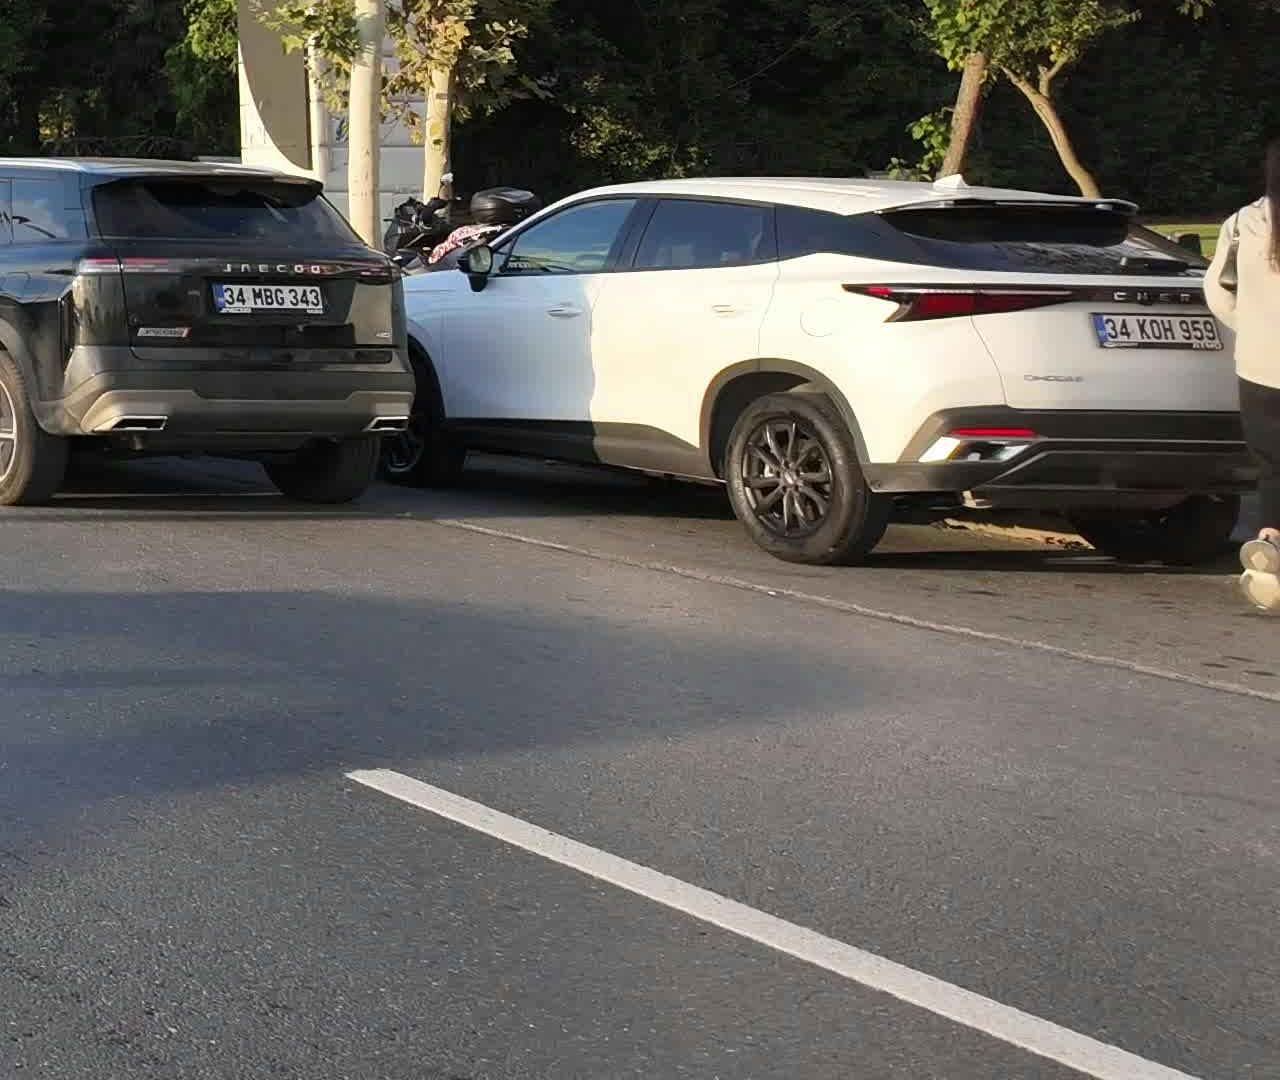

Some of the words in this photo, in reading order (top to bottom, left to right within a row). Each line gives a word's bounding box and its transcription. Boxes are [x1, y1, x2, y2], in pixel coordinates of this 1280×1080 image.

[224, 264, 321, 274] JAECOO
[224, 287, 246, 305] 34
[252, 287, 285, 306] MBG
[288, 288, 320, 307] 343
[1113, 291, 1192, 302] CHER
[1105, 318, 1131, 339] 34
[1136, 319, 1175, 340] KOH
[1179, 320, 1216, 340] 959
